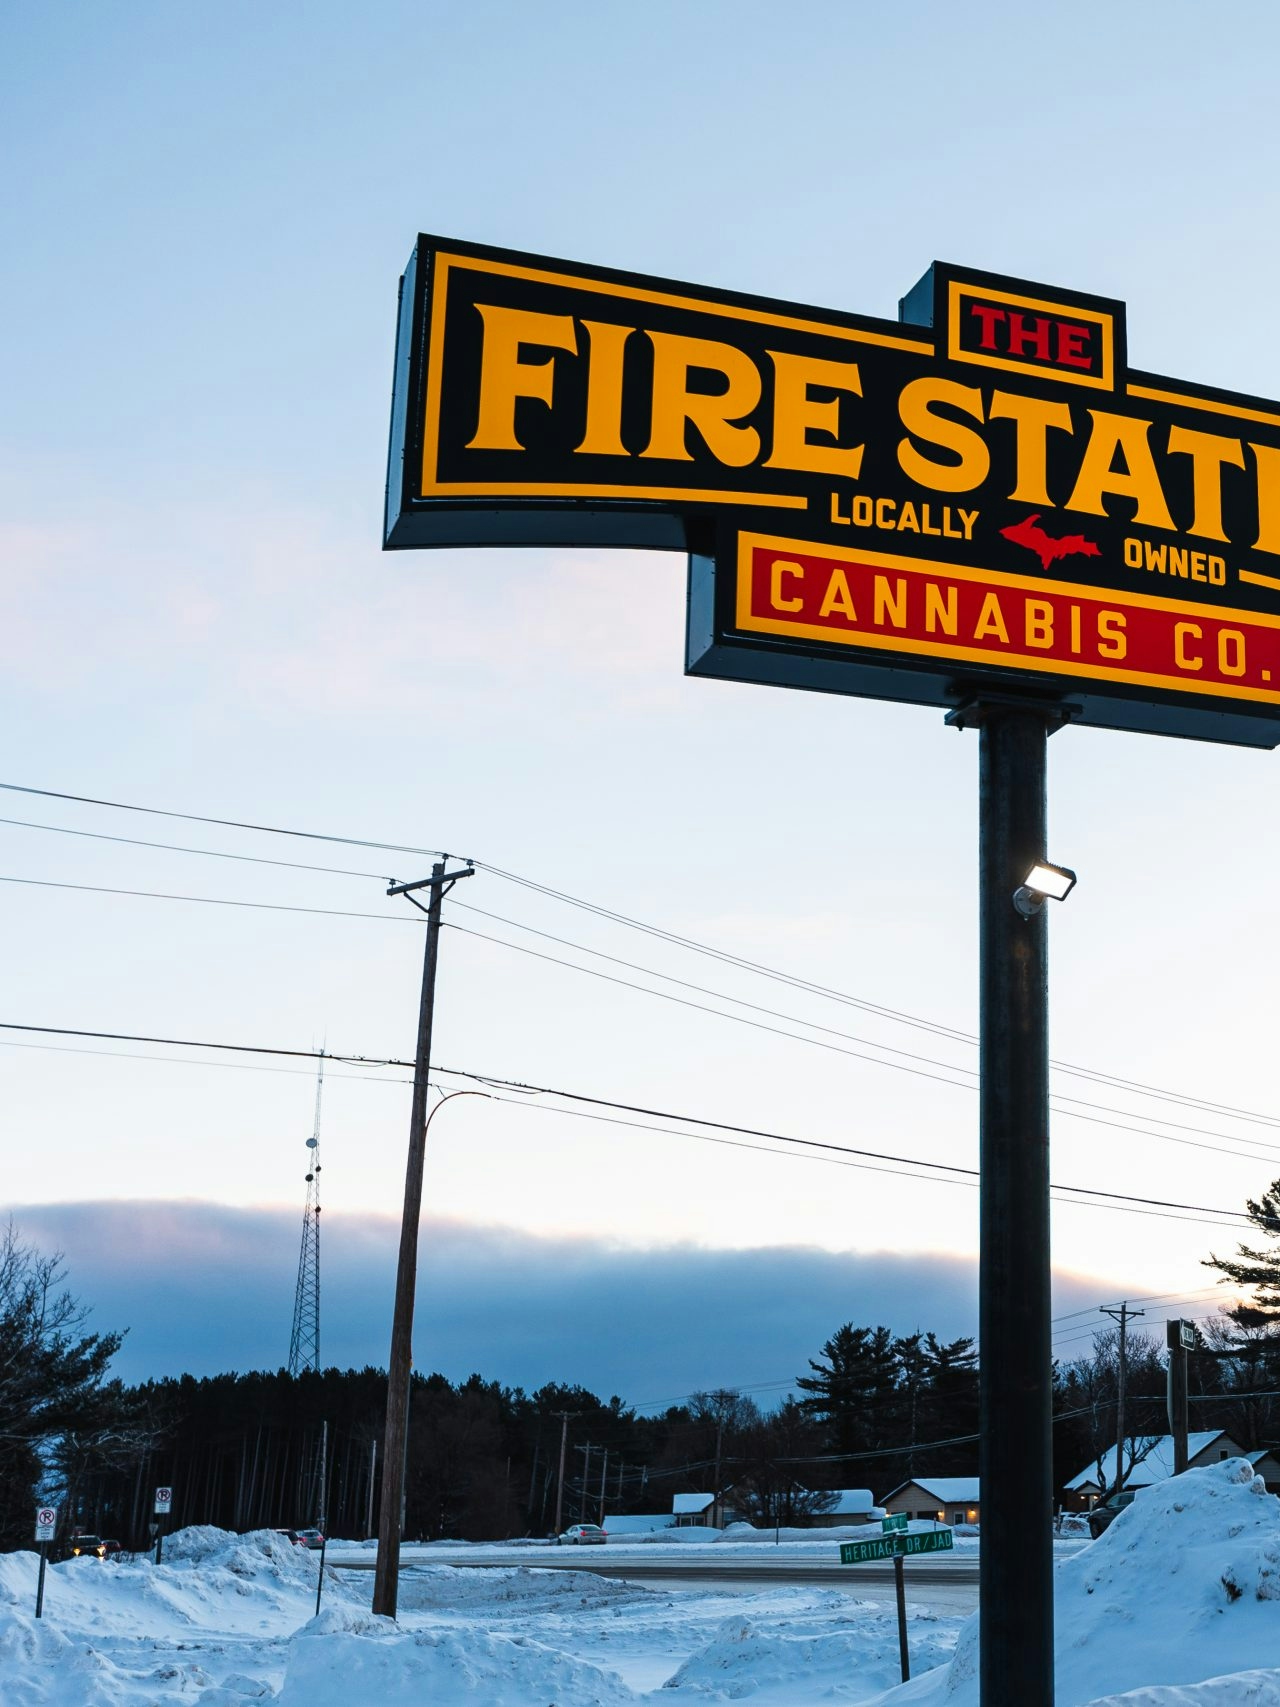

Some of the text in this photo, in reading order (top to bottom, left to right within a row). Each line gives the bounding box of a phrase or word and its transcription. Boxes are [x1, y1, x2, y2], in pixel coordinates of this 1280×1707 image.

[971, 304, 1092, 369] THE
[464, 303, 865, 480] FIRE
[831, 492, 1226, 587] LOCALLY OWNED
[770, 559, 1271, 681] CANNABIS CO.
[844, 1539, 899, 1561] HERITAGE
